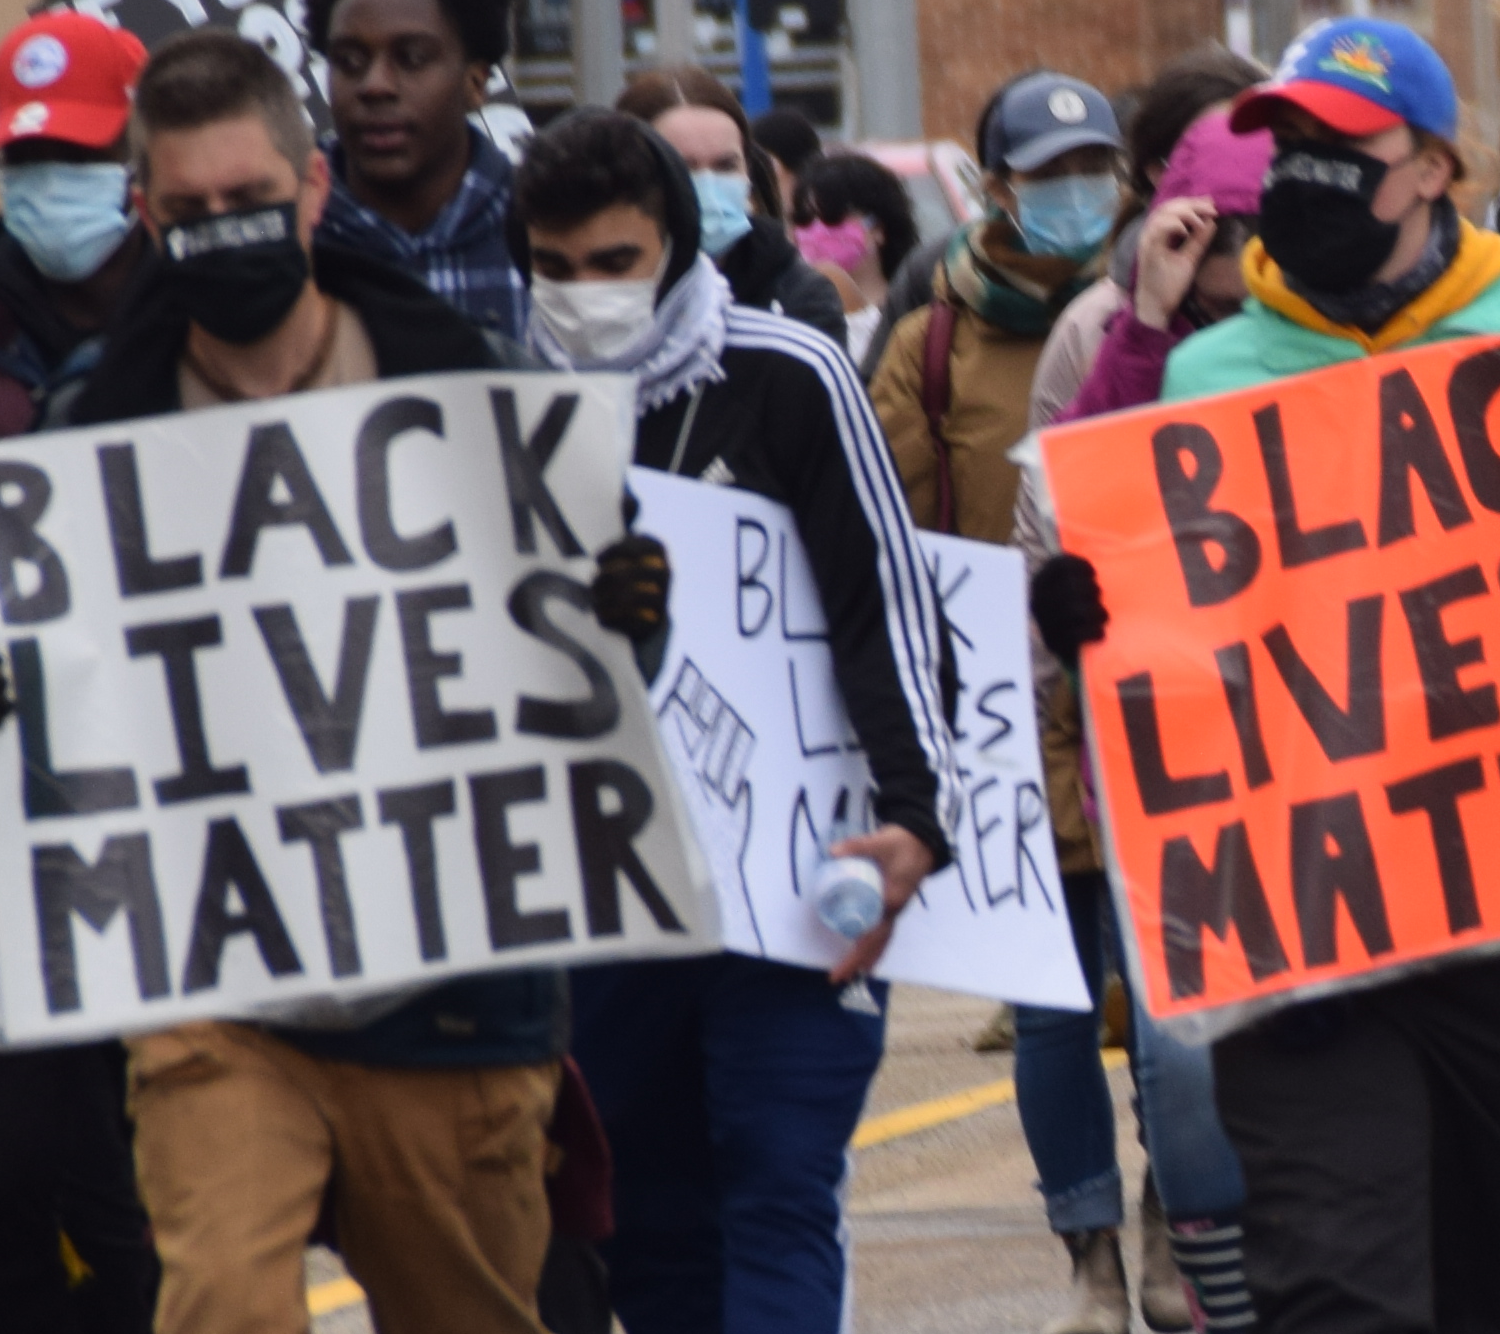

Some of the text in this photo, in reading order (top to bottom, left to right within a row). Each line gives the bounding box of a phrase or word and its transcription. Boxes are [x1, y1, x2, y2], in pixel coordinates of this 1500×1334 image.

[736, 517, 975, 653] BLK
[6, 569, 622, 822] LIVES
[30, 759, 690, 1017] MATTER
[790, 770, 1056, 915] MER
